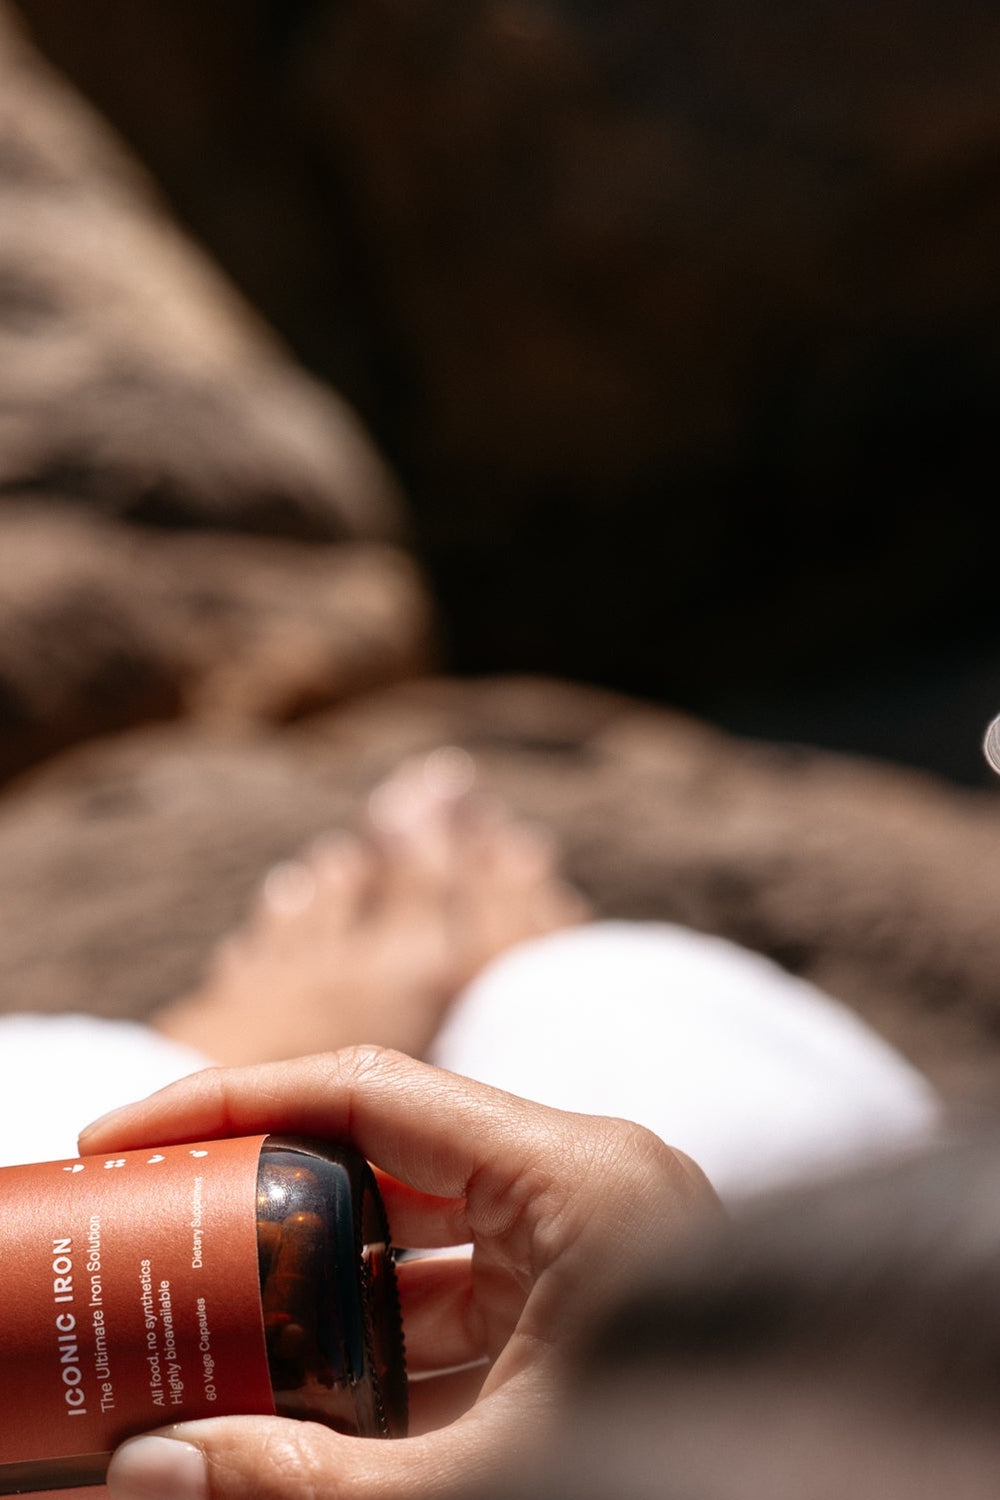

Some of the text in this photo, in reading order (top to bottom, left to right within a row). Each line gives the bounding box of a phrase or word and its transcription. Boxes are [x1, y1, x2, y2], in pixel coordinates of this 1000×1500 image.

[86, 1215, 115, 1412] The Ultimate Iron Solution
[192, 1228, 204, 1269] Dietary
[52, 1237, 87, 1416] ICONIC IRON
[139, 1259, 165, 1406] All food, no synthetics
[158, 1280, 184, 1405] Highly bioavailable
[197, 1298, 217, 1401] 60 Vege Capsules
